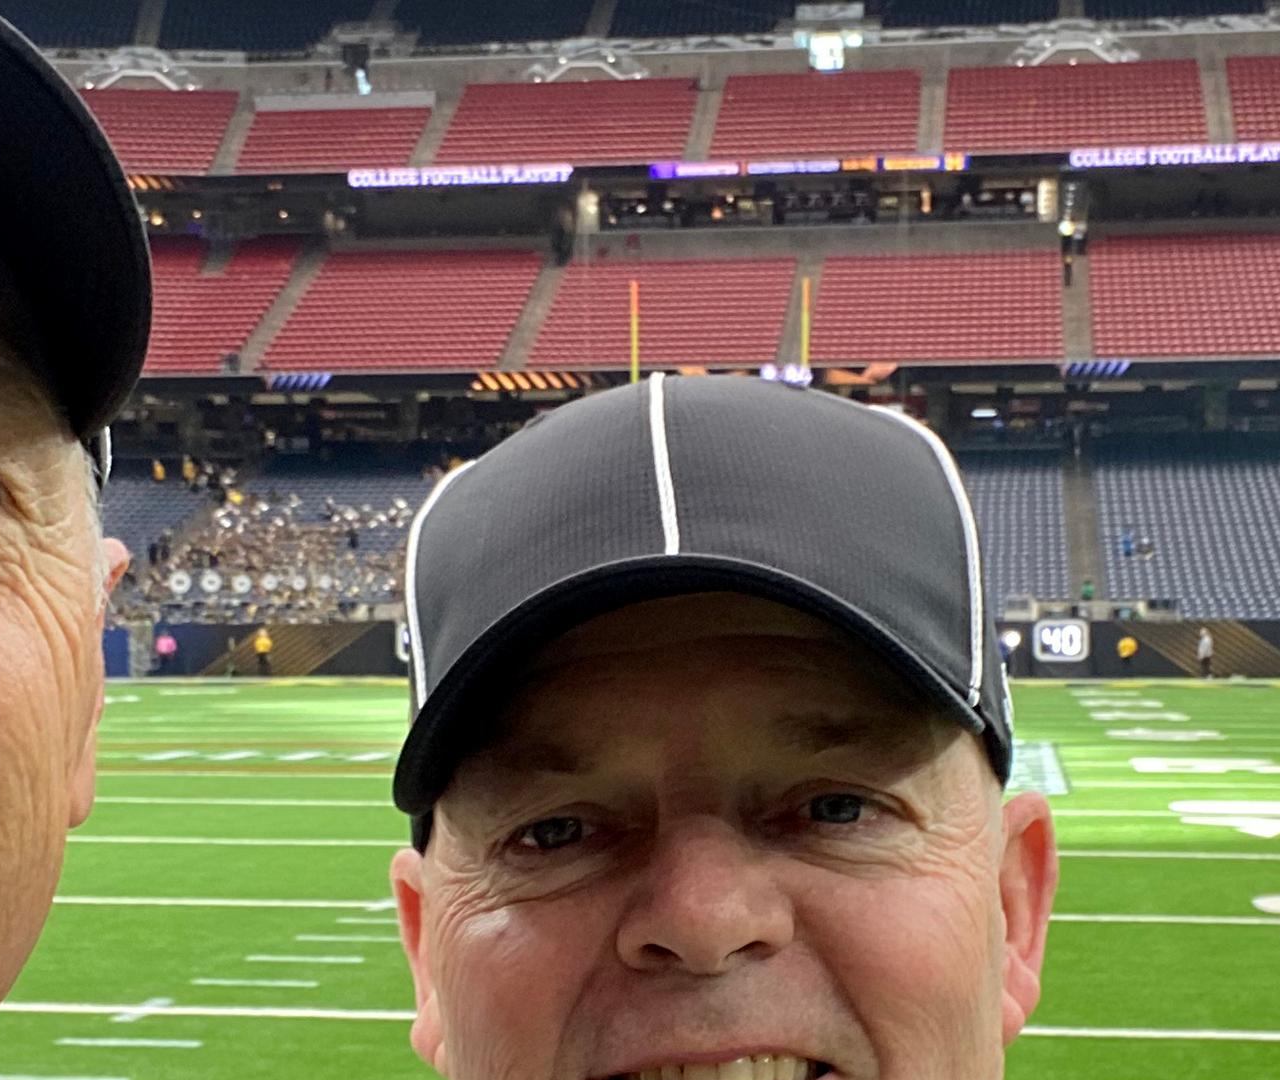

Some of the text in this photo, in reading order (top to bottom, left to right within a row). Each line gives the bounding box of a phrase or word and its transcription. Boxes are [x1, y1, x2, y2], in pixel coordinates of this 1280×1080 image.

[1070, 147, 1148, 167] COLLEGE
[1149, 143, 1237, 165] FOOTBALL
[348, 163, 573, 188] COLLEGE FOOTBALL PLAYOFF
[1041, 624, 1083, 657] 40
